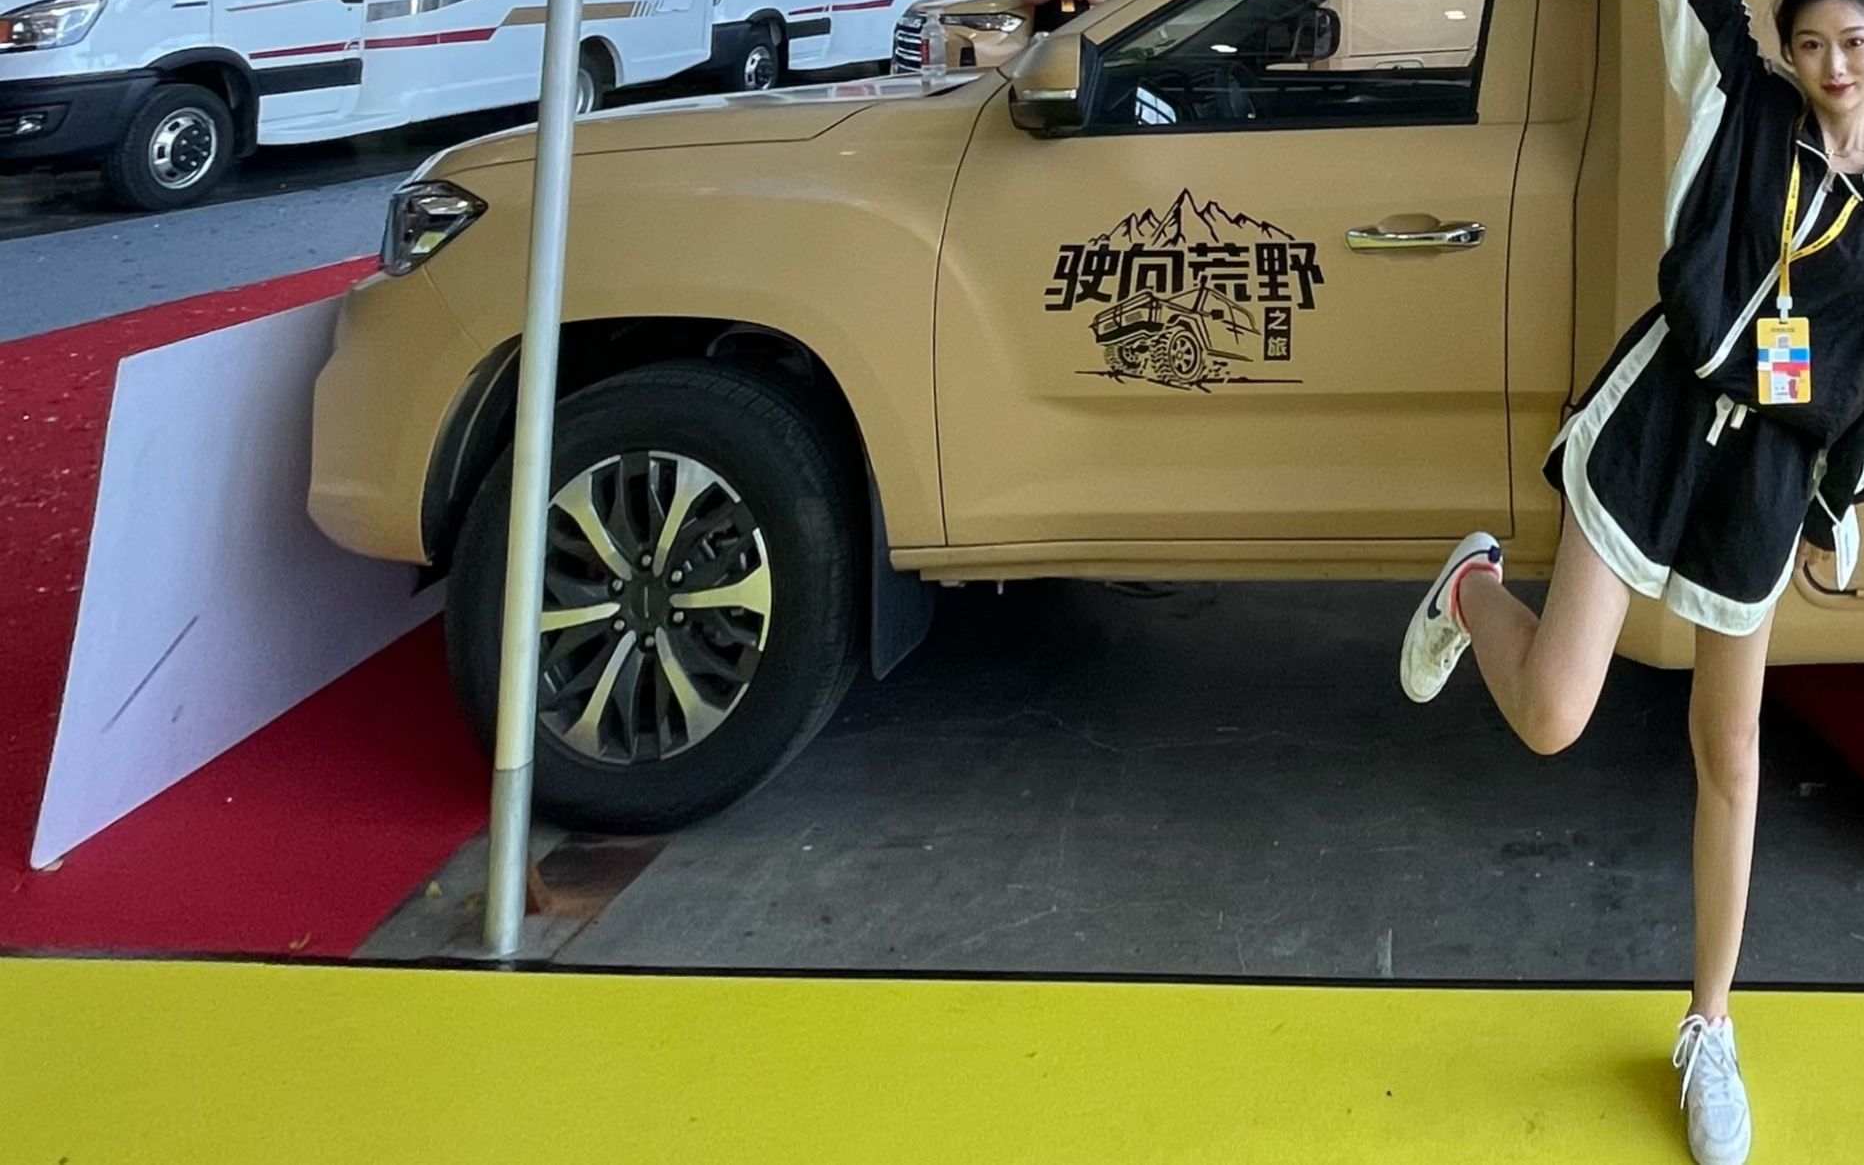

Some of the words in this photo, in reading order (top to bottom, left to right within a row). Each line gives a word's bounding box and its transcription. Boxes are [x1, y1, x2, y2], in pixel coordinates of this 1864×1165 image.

[1044, 242, 1325, 311] 驶向荒野
[1267, 309, 1289, 357] 之旅
